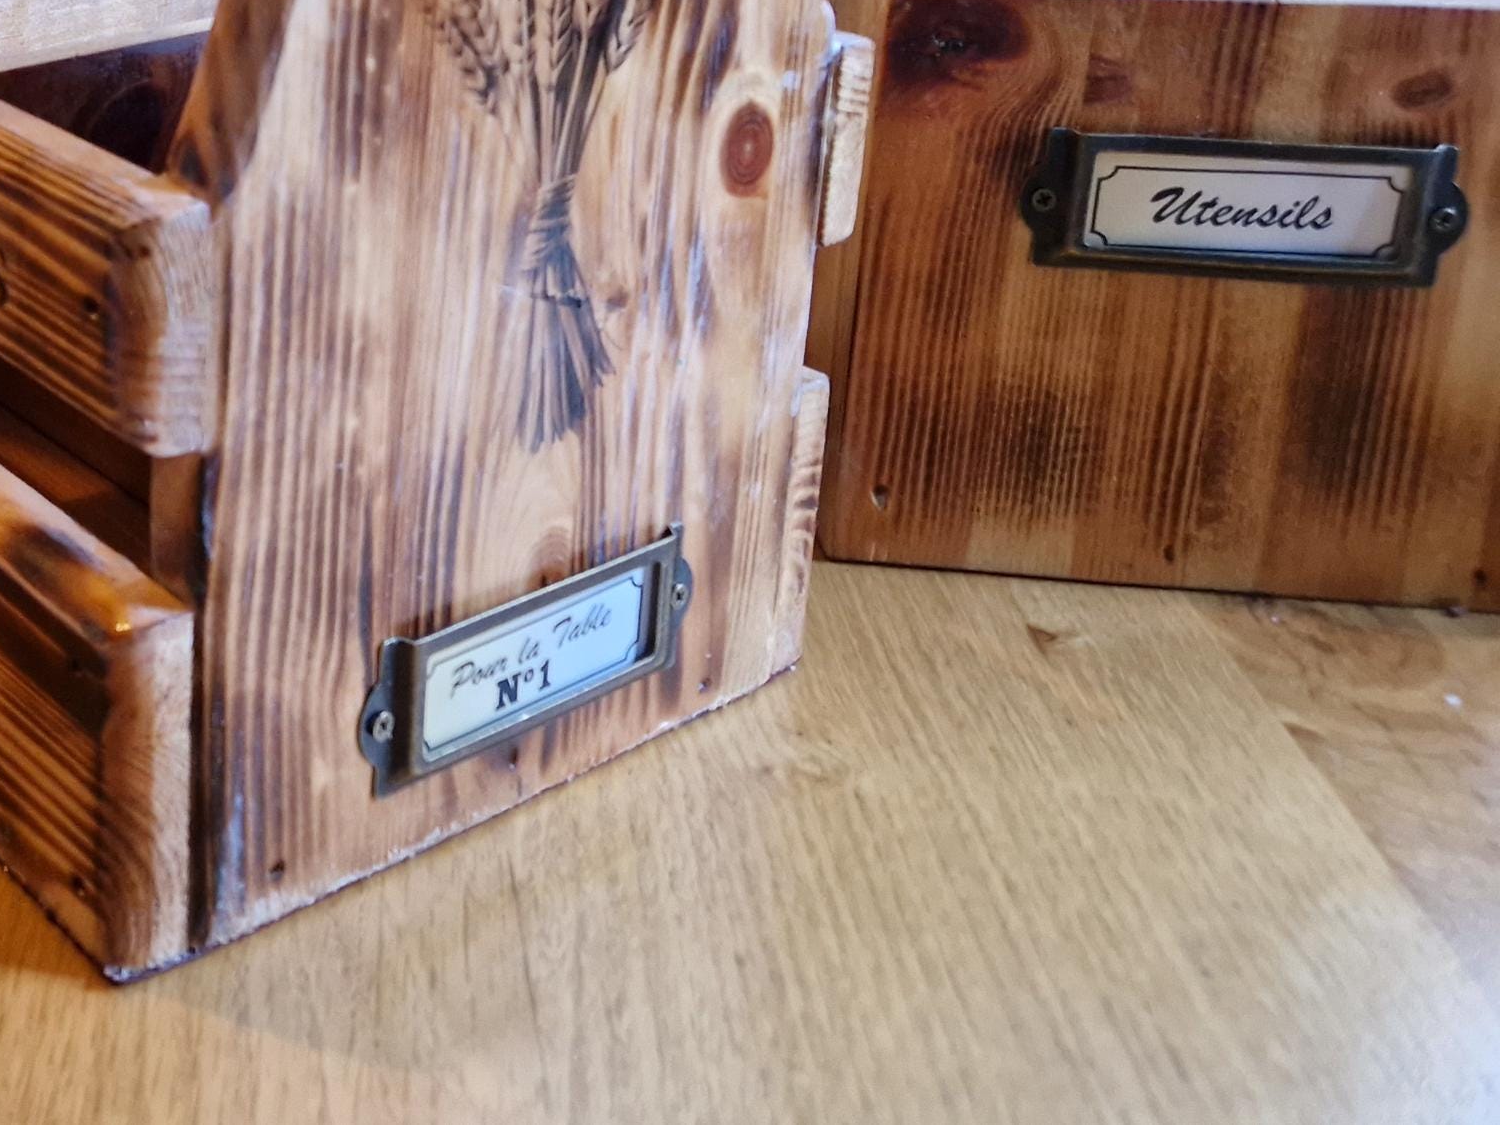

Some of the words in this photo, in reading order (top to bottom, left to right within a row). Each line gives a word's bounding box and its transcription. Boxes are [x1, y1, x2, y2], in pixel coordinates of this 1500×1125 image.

[1150, 186, 1334, 231] Utensils
[449, 657, 508, 700] Pour
[518, 636, 540, 665] la
[552, 602, 612, 650] Table
